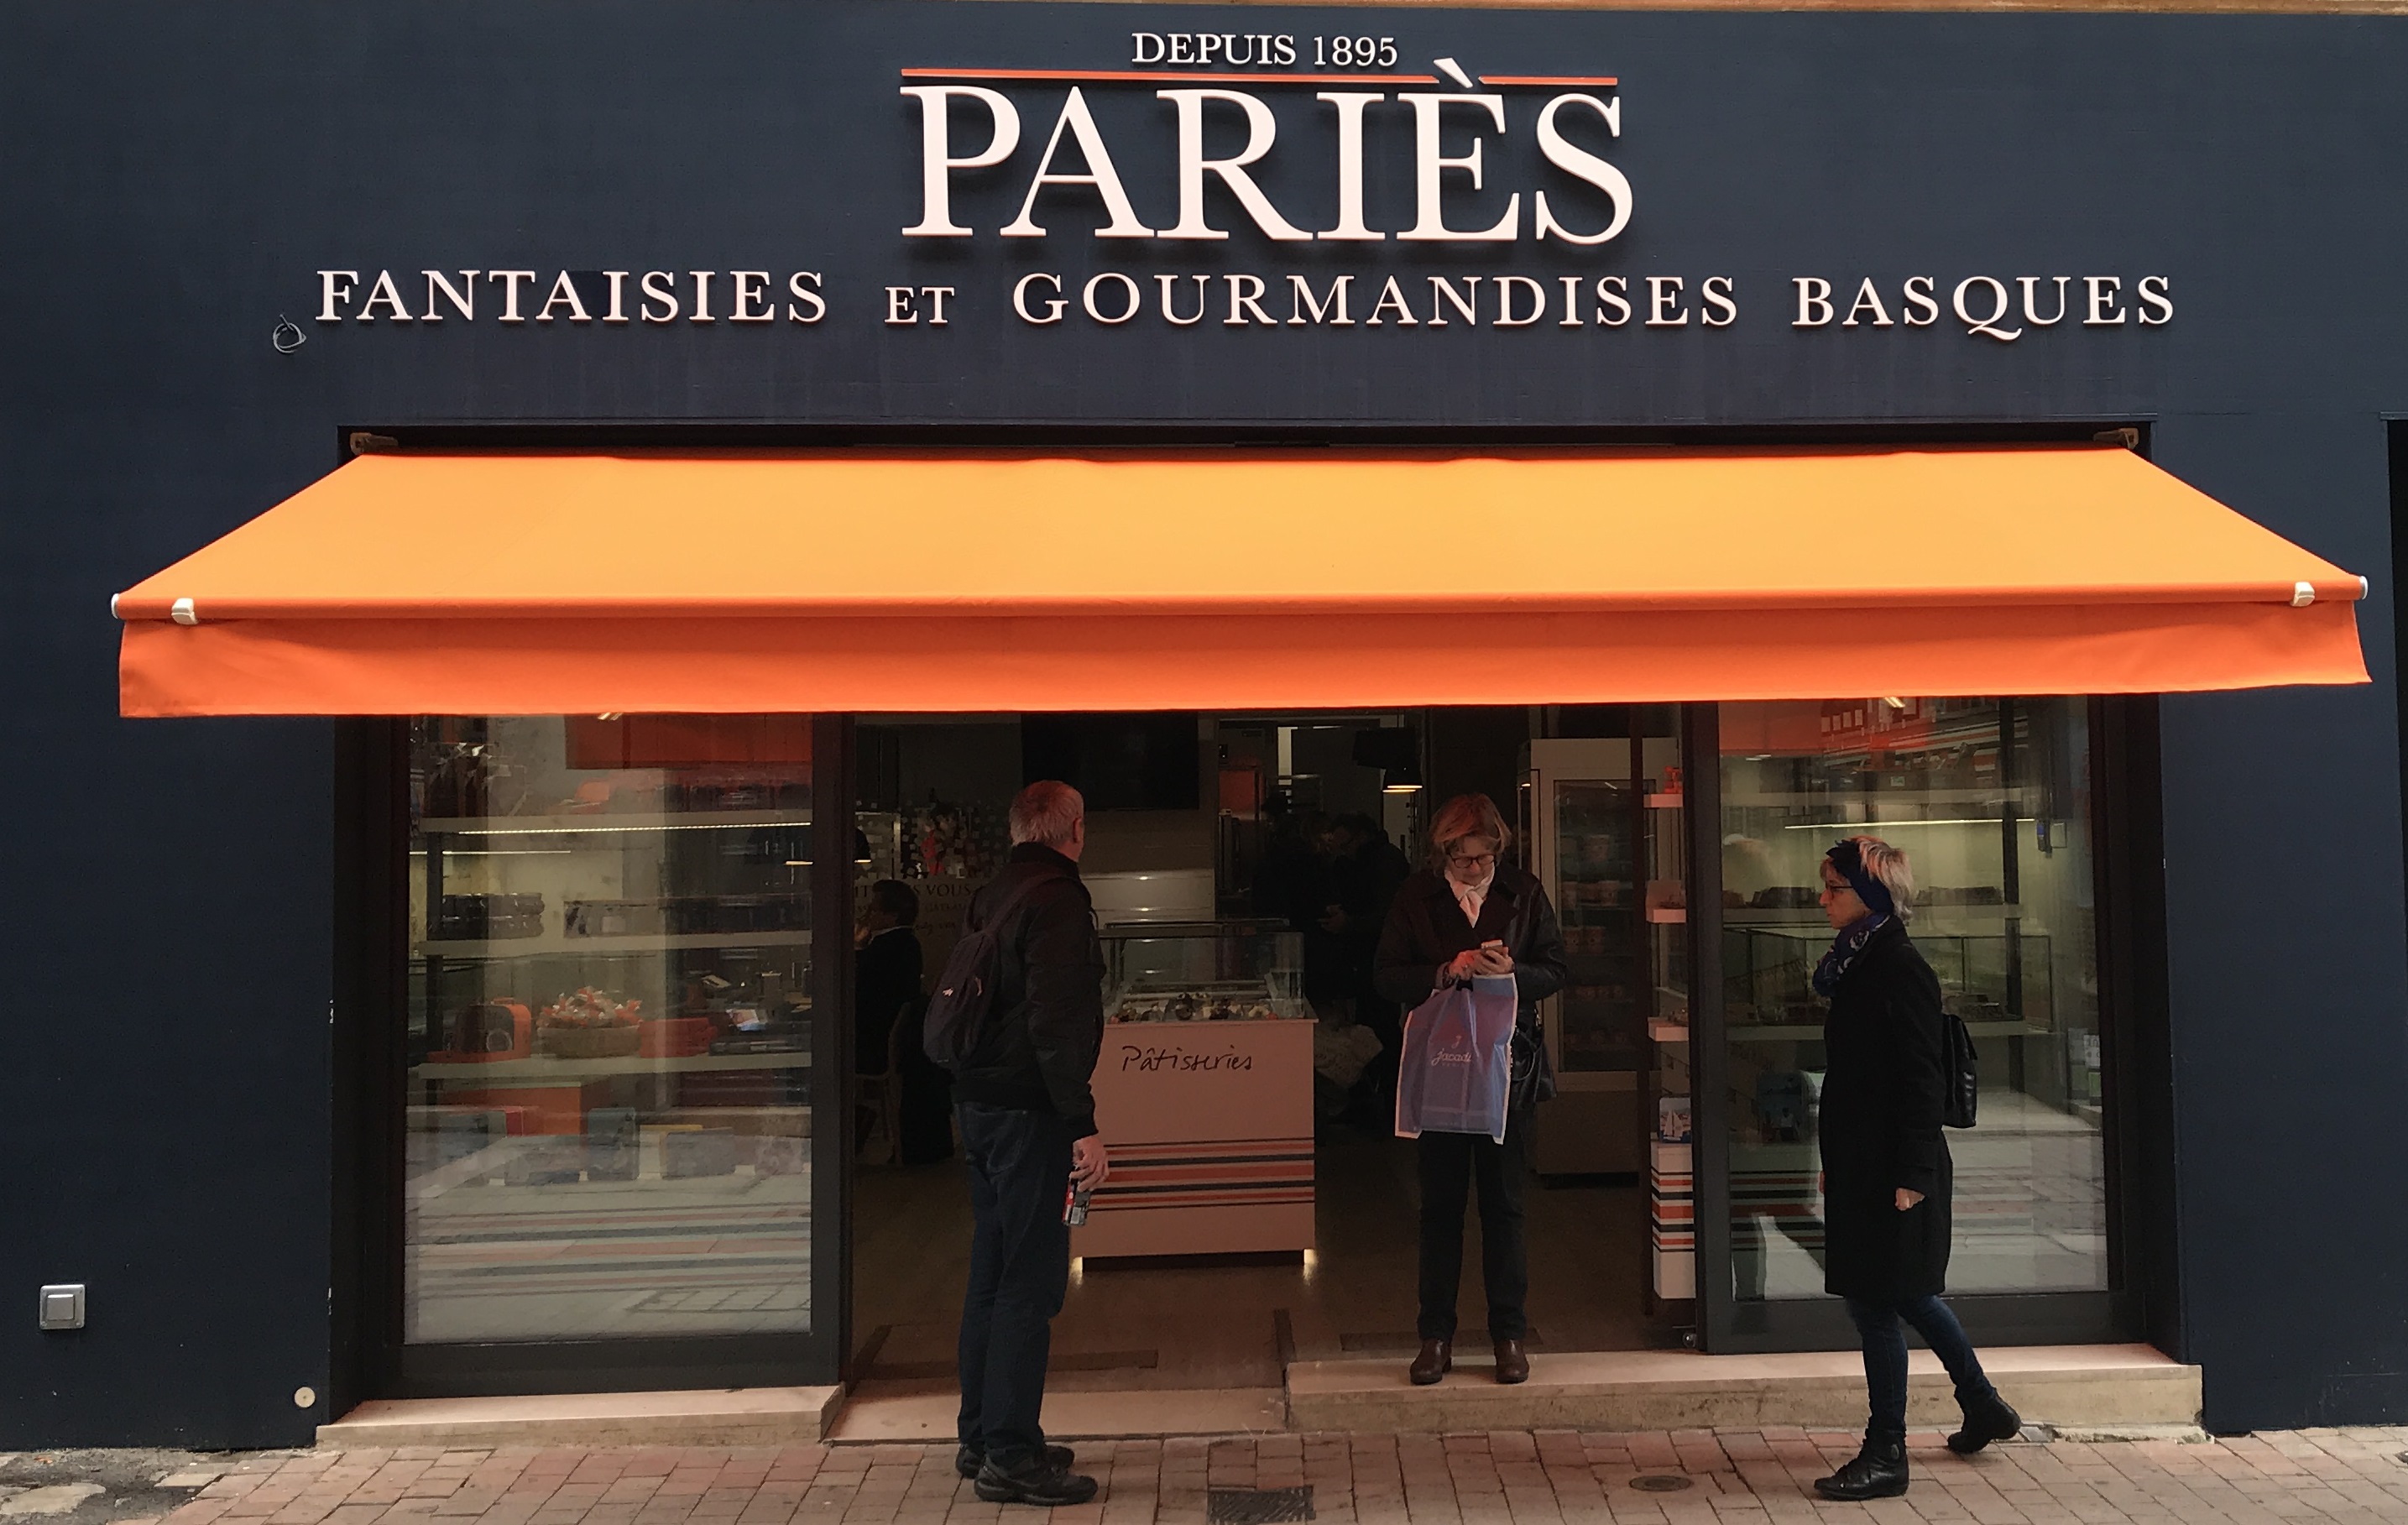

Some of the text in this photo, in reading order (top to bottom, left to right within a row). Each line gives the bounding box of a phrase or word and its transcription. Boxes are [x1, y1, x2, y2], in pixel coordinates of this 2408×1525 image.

[1131, 33, 1398, 67] DEPUIS 1895
[900, 57, 1633, 245] PARIÈS
[315, 269, 2174, 342] FANTAISIES ET GOURMANDISES BASQUES
[926, 883, 971, 897] VOUS
[1121, 1044, 1252, 1072] Pâtisseries
